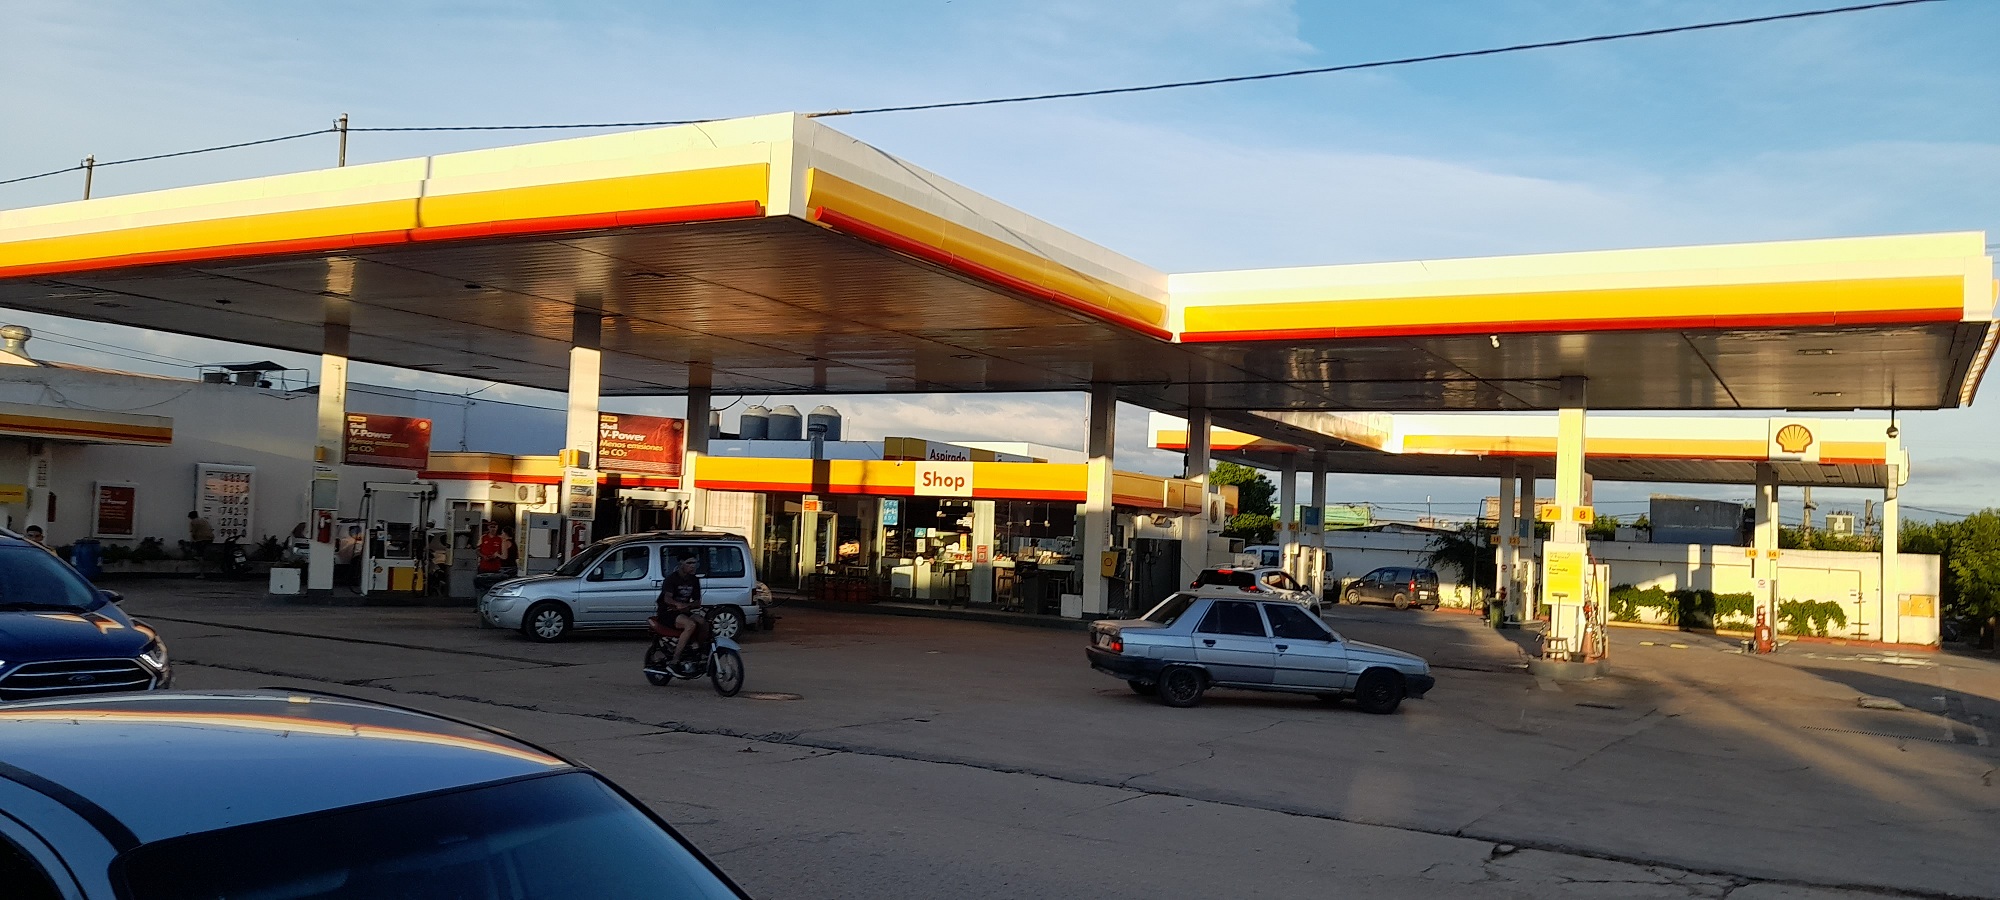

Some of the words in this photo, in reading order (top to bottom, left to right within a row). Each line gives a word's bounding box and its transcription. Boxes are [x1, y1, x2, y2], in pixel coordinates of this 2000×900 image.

[600, 422, 618, 430] Shell
[349, 428, 393, 439] V-Power
[600, 429, 646, 441] V-Power
[599, 440, 626, 448] Menos
[626, 442, 664, 451] emisiones
[599, 447, 610, 456] de
[930, 449, 967, 462] Aspirado
[923, 471, 965, 491] Shop
[1545, 508, 1553, 518] 7
[1579, 510, 1587, 520] 8
